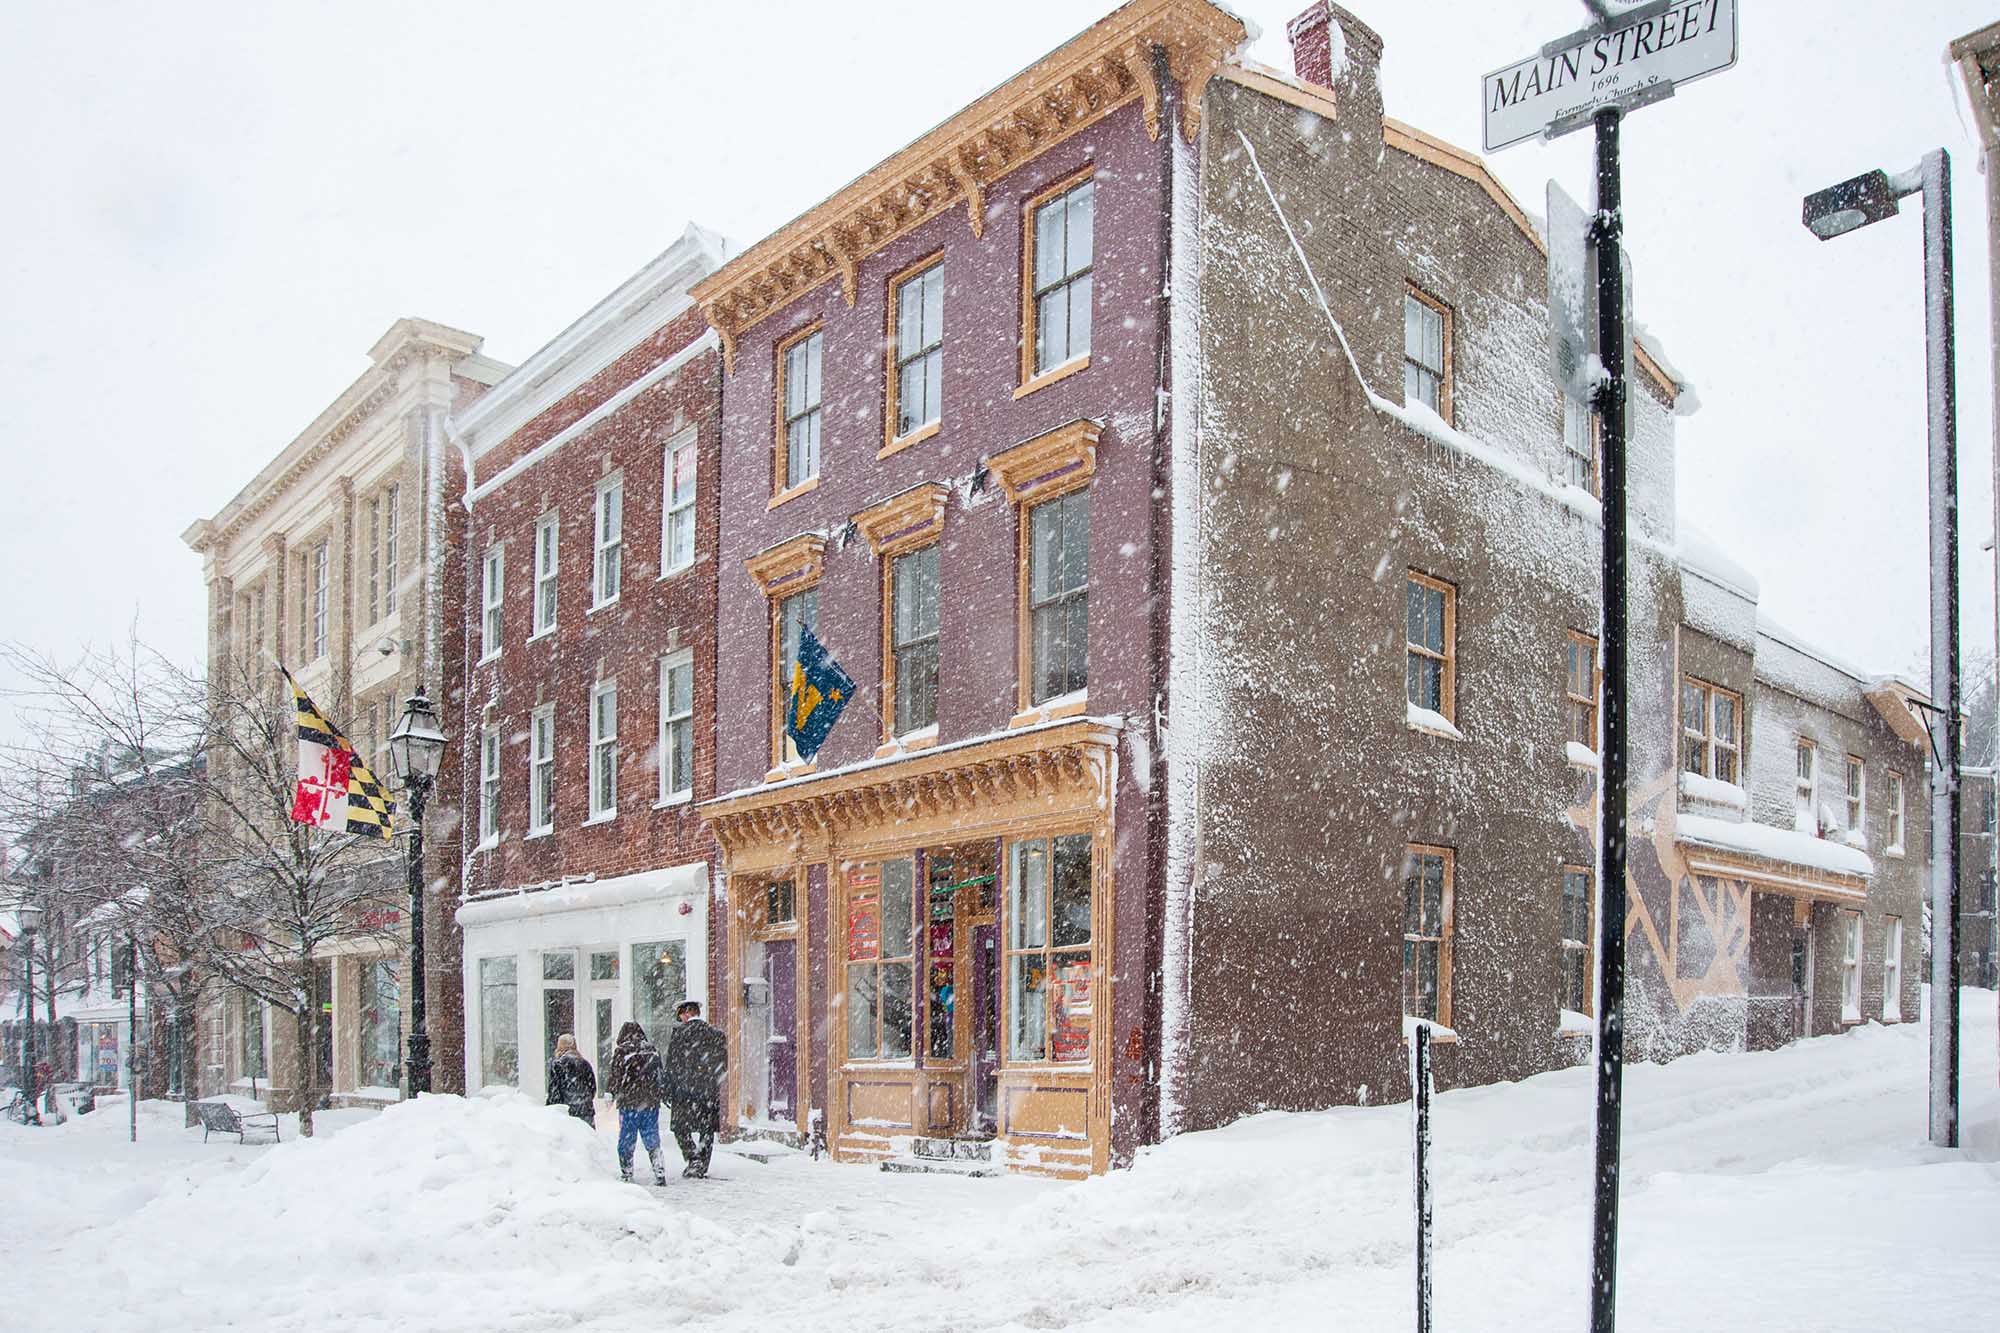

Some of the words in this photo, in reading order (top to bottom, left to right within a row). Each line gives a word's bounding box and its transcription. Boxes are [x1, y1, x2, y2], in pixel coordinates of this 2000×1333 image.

[1491, 47, 1584, 113] MAIN
[1590, 0, 1719, 76] STREET
[1591, 72, 1620, 92] 1696
